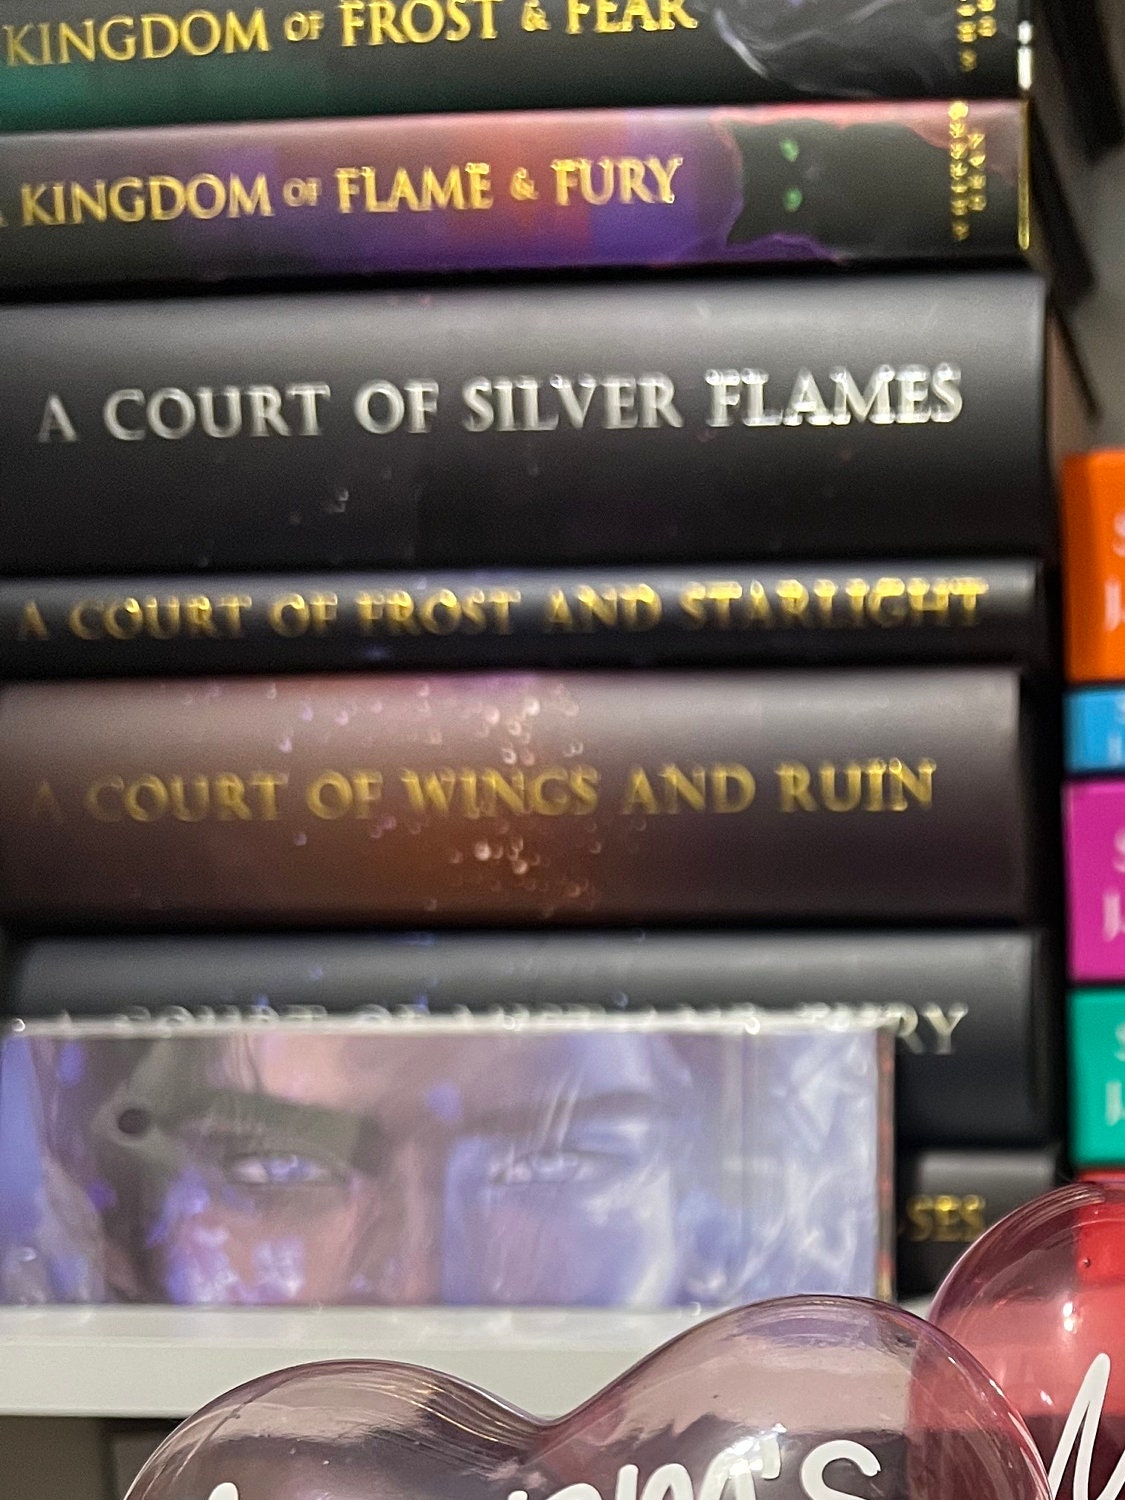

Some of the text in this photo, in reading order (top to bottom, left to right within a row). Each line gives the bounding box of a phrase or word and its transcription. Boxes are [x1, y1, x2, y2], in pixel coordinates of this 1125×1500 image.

[1, 7, 271, 66] KINGDOM
[283, 10, 325, 41] OF
[341, 0, 498, 46] FROST
[21, 172, 274, 227] KINGDOM
[335, 162, 493, 213] FLAME
[510, 167, 539, 201] &
[551, 155, 683, 206] FURY
[37, 362, 963, 443] A COURT OF SILVER FLAMES
[17, 577, 989, 641] A COURT OF FROST AND STARLIGHT
[30, 758, 937, 822] A COURT OF WINGS AND RUIN
[906, 1195, 985, 1243] SES
